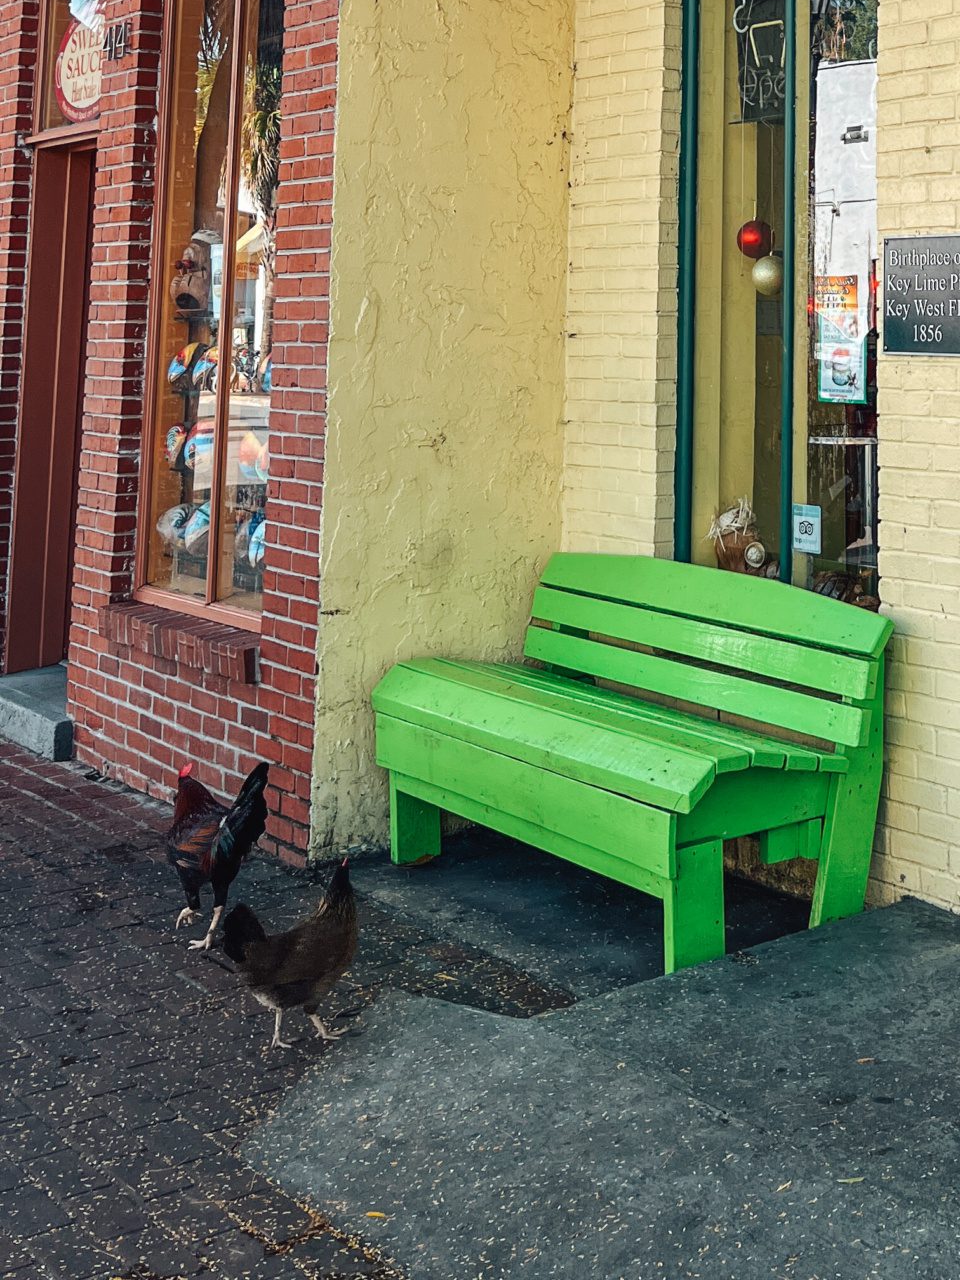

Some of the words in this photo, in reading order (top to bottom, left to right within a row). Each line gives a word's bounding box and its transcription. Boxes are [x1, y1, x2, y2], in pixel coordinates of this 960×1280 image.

[889, 248, 951, 270] Birthplace
[887, 274, 911, 295] Key
[914, 273, 946, 291] Lime
[886, 299, 911, 320] Key
[913, 299, 945, 317] West
[913, 324, 943, 342] 1856
